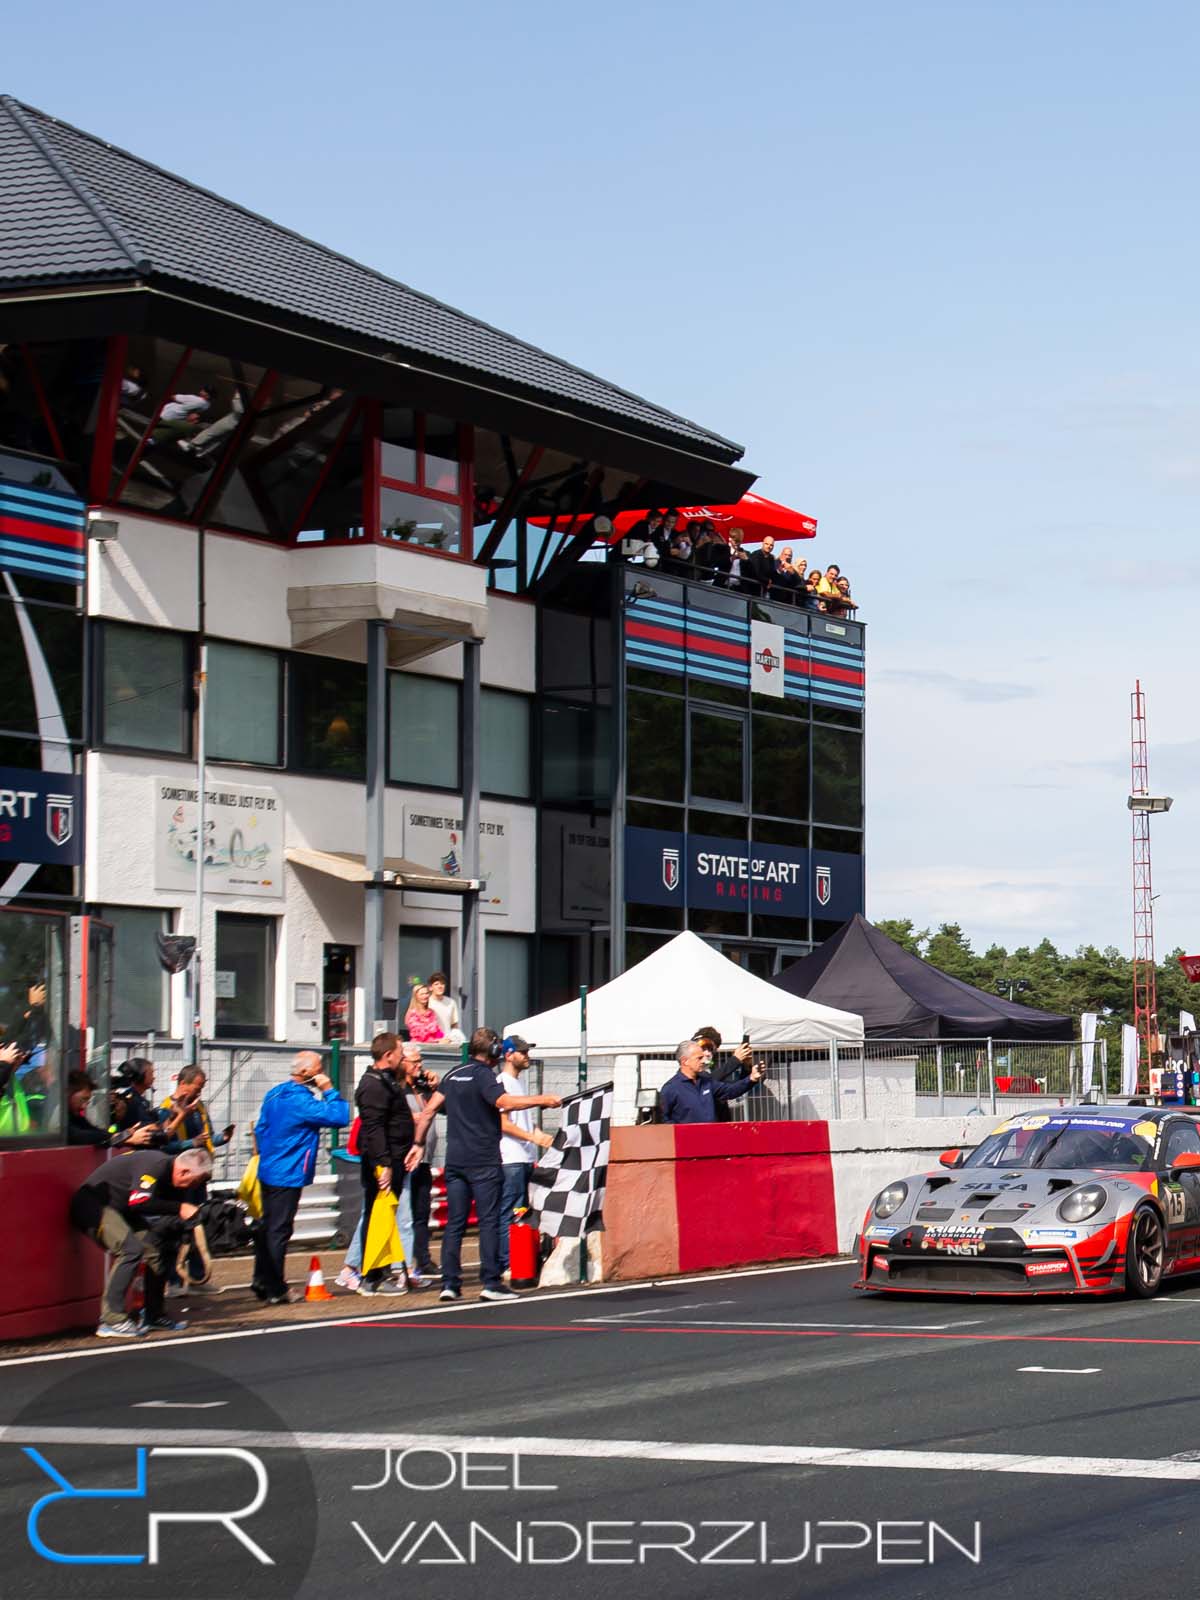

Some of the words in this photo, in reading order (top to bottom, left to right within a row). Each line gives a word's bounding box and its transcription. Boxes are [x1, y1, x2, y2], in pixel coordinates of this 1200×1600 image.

[0, 789, 38, 818] RT
[161, 787, 199, 802] SOMETIME
[697, 852, 749, 879] STATE
[751, 859, 766, 880] OF
[766, 861, 800, 884] ART
[716, 880, 783, 902] RACING
[1169, 1193, 1183, 1217] 15
[926, 1224, 986, 1235] KRISMAR
[1027, 1262, 1068, 1272] CHAMPION
